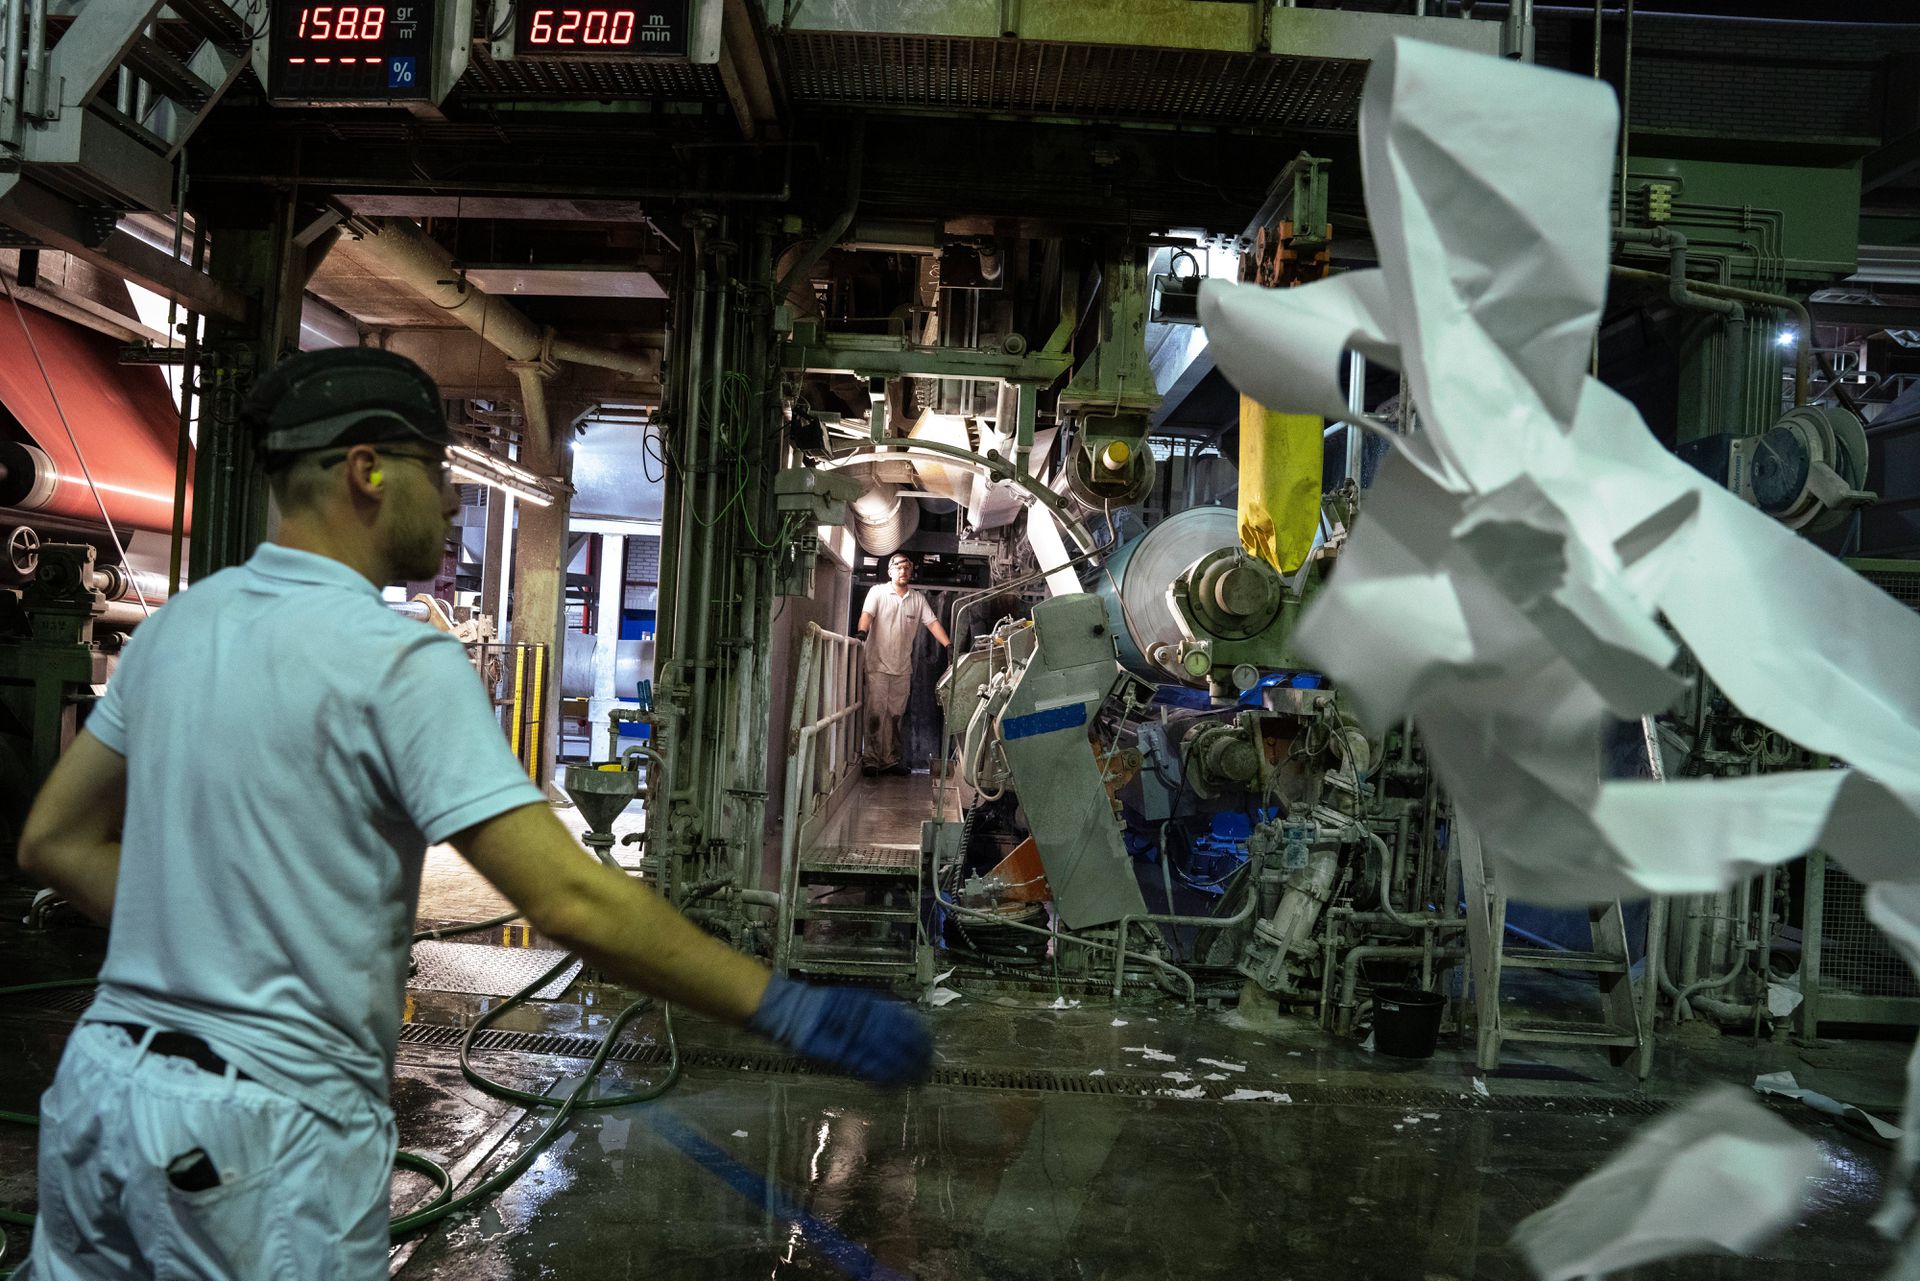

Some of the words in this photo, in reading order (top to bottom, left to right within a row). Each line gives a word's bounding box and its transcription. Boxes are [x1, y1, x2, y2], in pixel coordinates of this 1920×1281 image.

[396, 7, 414, 20] gr
[650, 14, 663, 25] m
[298, 7, 385, 39] 158.8
[530, 10, 635, 44] 620.0
[641, 28, 671, 42] min
